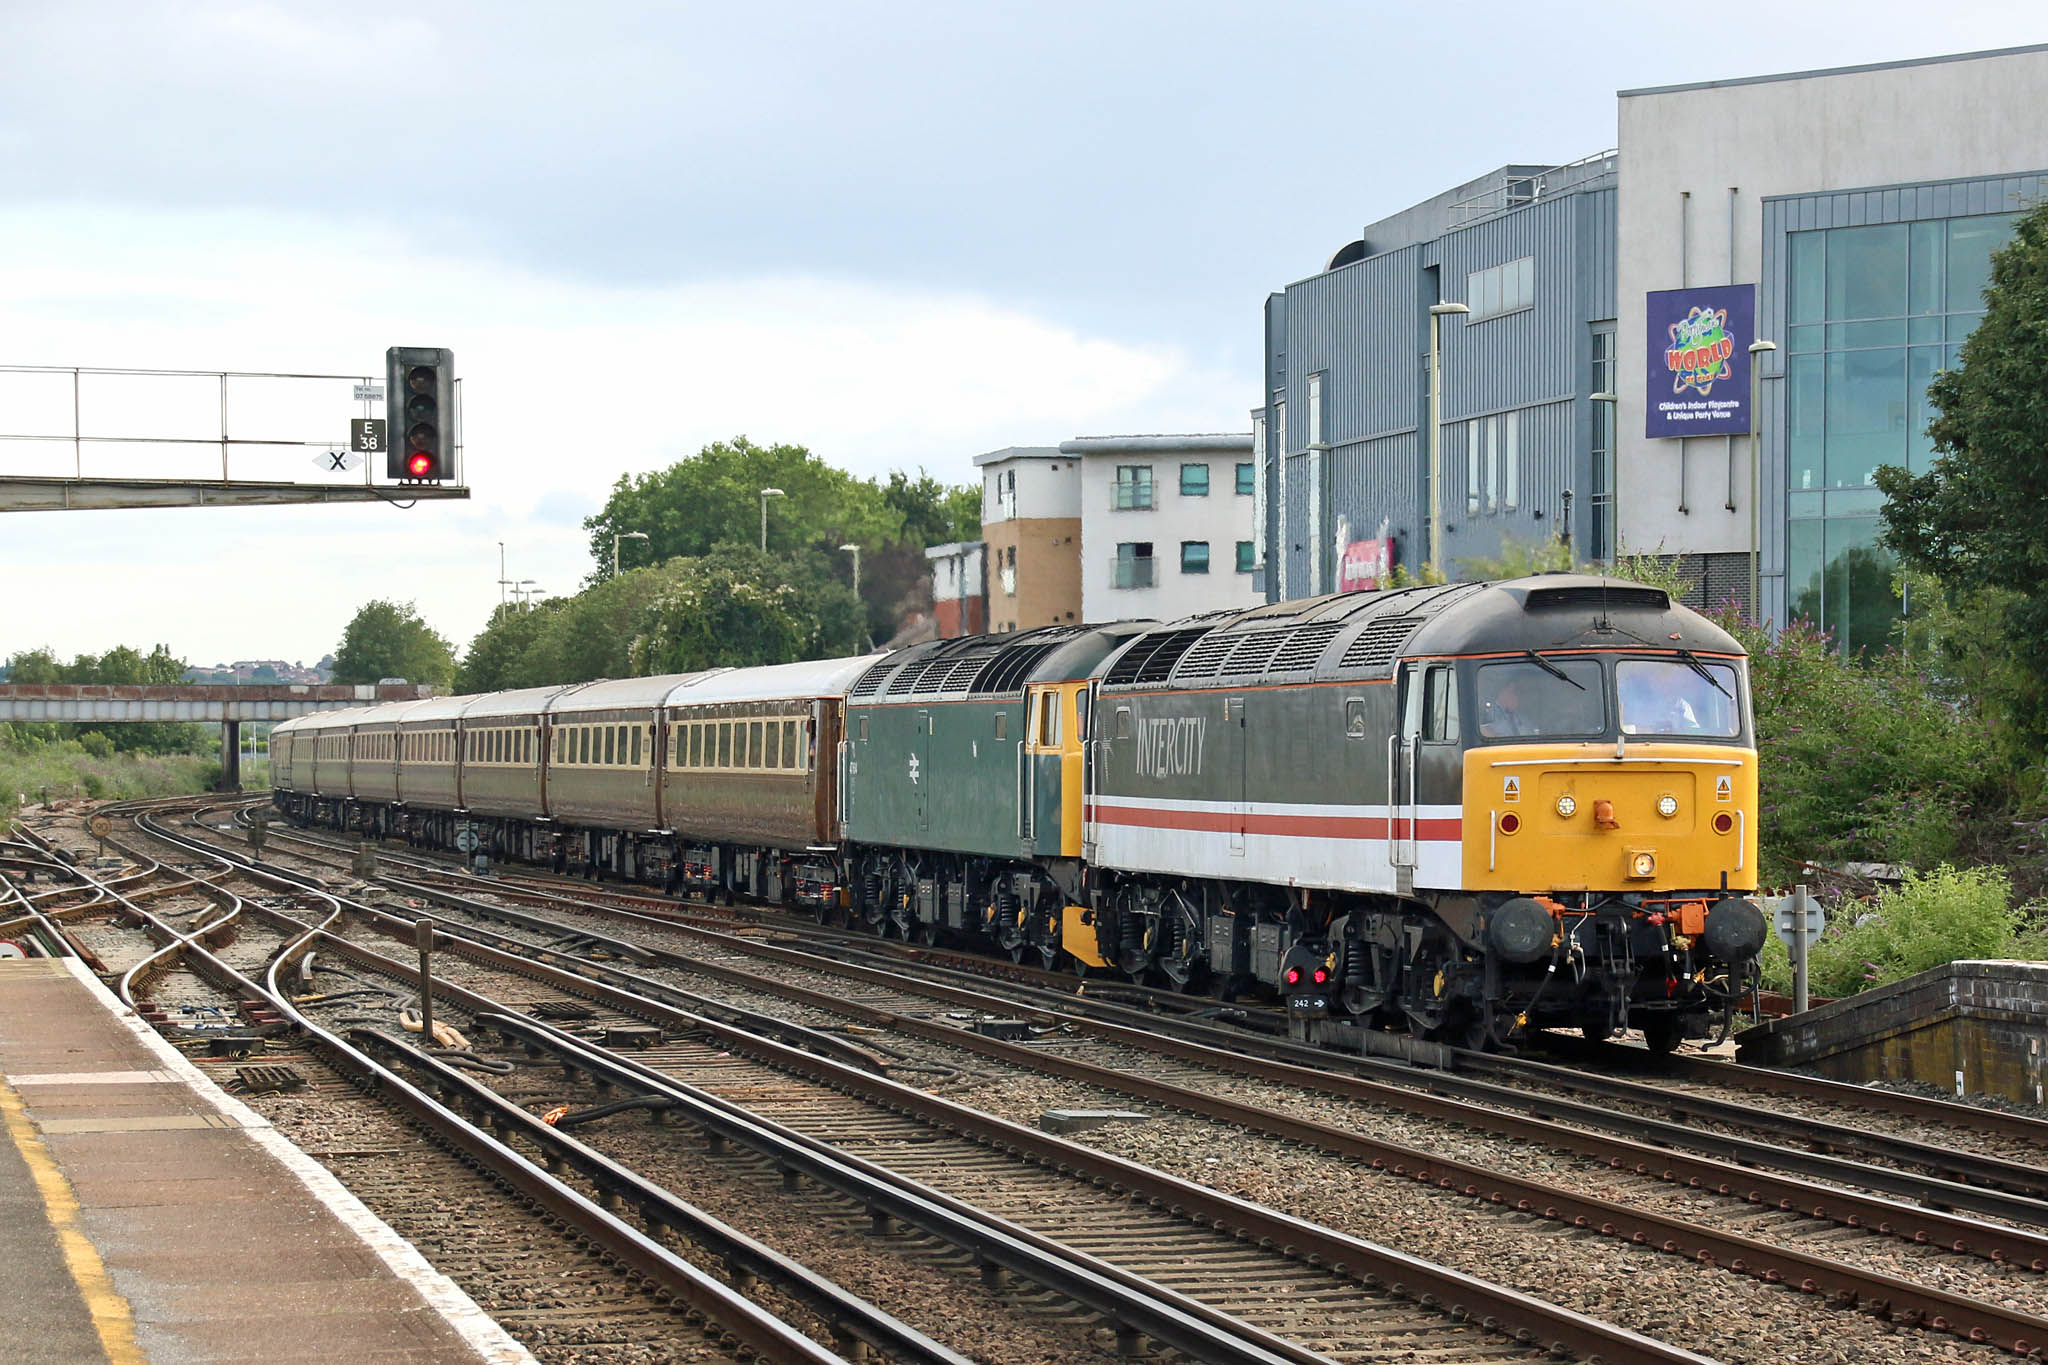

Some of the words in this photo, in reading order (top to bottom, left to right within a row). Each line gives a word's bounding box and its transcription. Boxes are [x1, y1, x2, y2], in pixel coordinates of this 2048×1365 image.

[1668, 338, 1732, 372] WORLD
[1659, 402, 1687, 411] Children's
[1688, 401, 1707, 410] Indoor
[1708, 400, 1740, 410] Playcentre
[1666, 412, 1672, 420] &
[1673, 411, 1694, 420] Unique
[1695, 411, 1711, 421] Party
[1712, 410, 1731, 419] Venue
[364, 422, 373, 434] E
[360, 437, 378, 450] 38
[329, 452, 346, 470] X
[1136, 717, 1206, 777] INTERCITY
[1294, 999, 1309, 1008] 242
